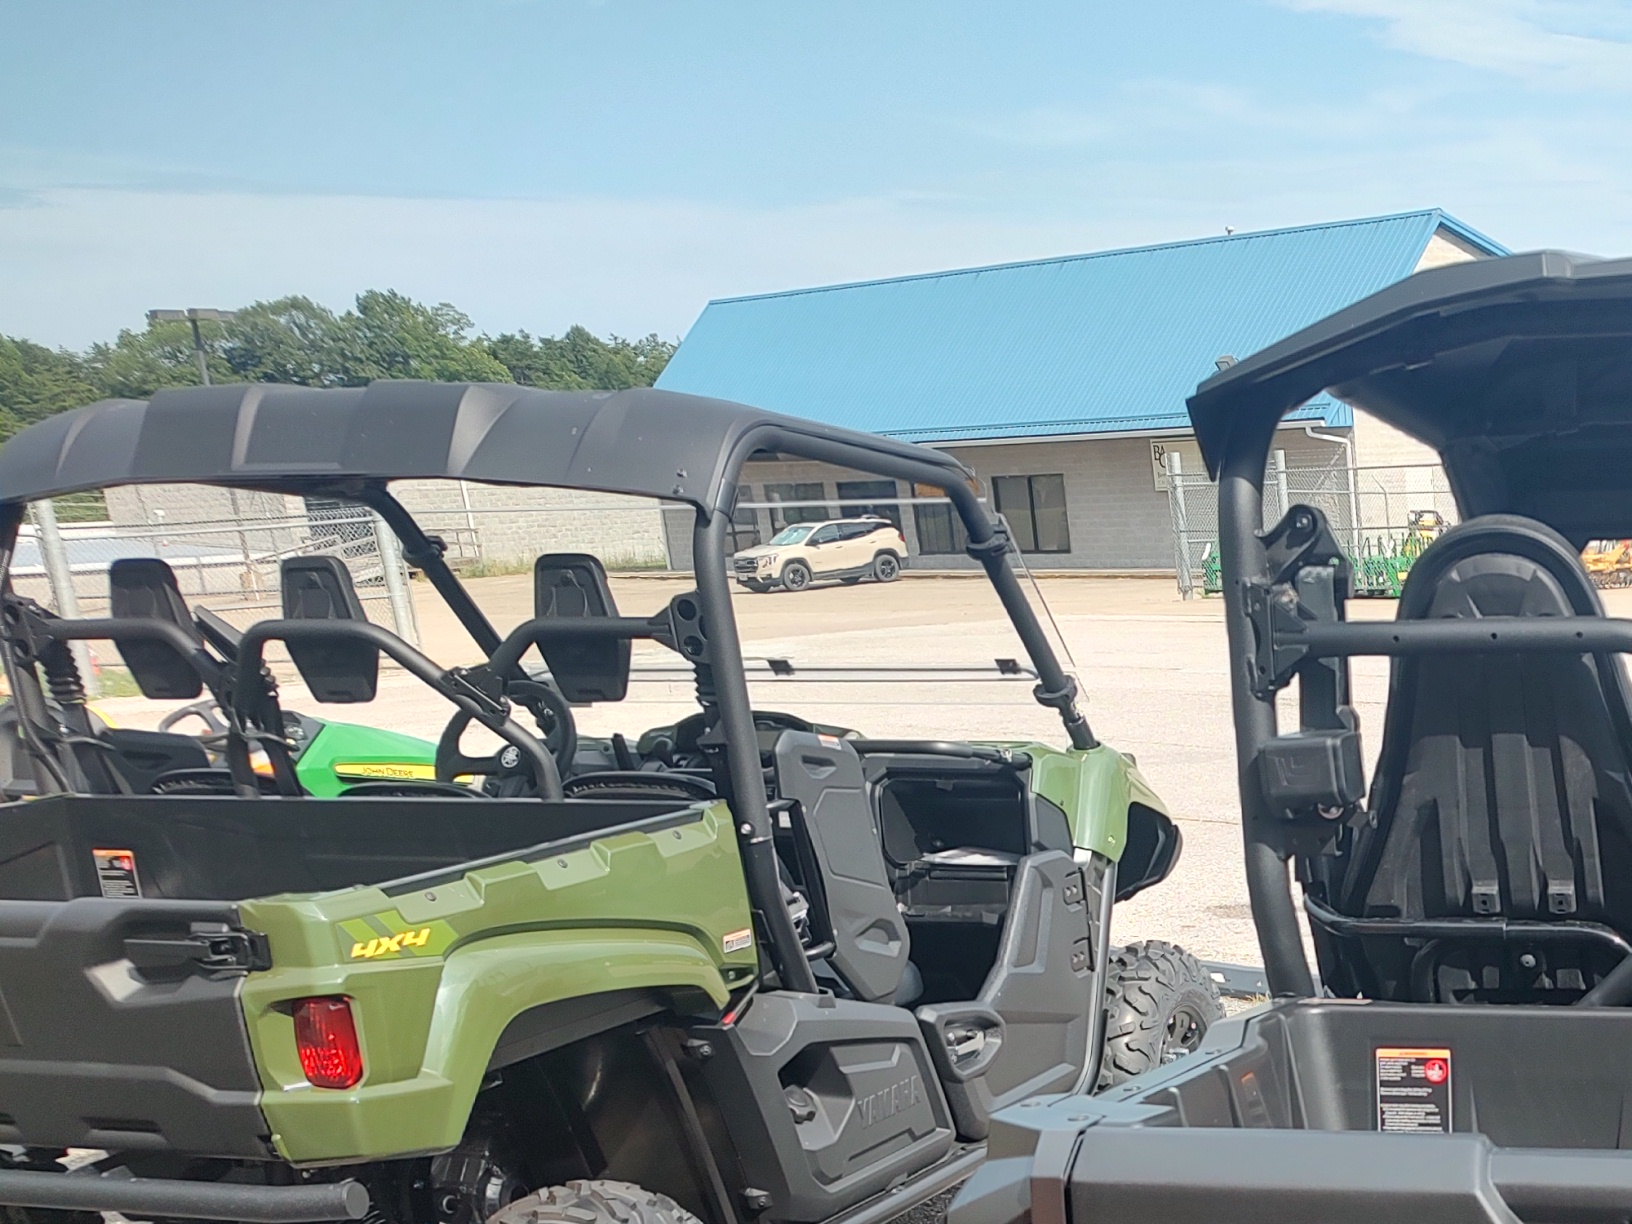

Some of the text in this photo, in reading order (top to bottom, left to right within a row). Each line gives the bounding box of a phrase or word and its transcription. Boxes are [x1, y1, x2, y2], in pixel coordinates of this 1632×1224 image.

[362, 767, 414, 778] JOHN DEERE
[857, 1075, 920, 1130] YAMAHA
